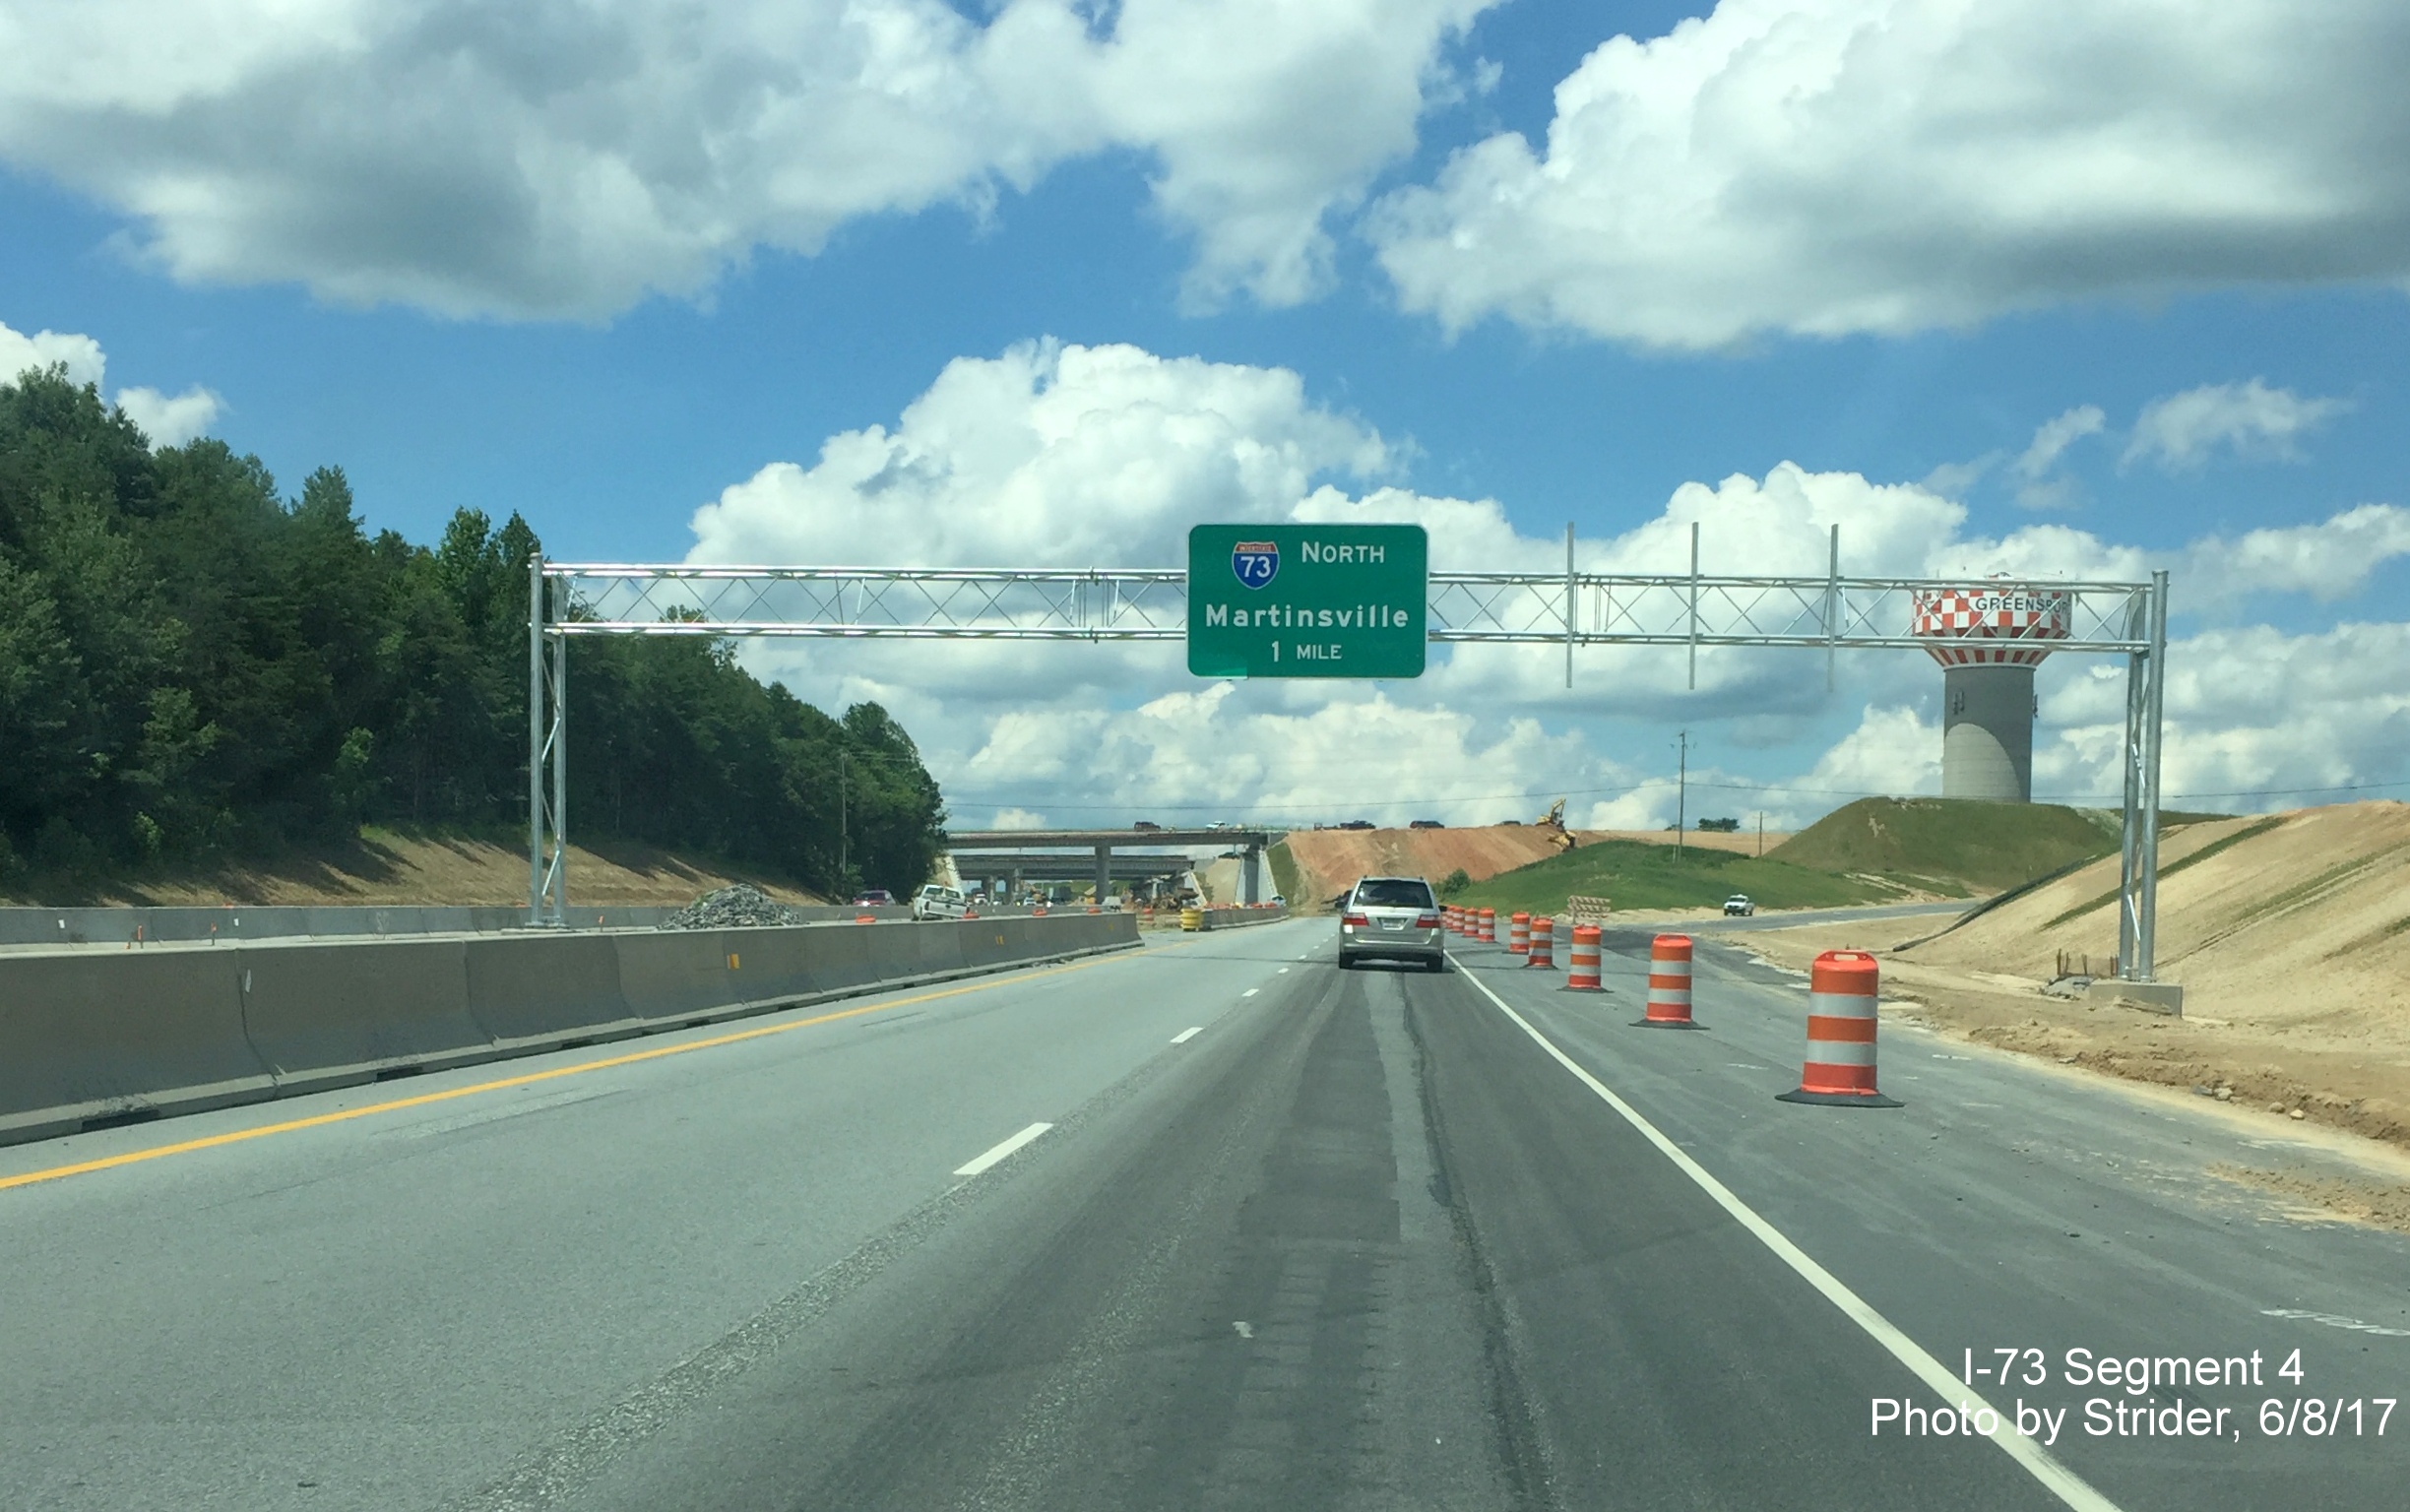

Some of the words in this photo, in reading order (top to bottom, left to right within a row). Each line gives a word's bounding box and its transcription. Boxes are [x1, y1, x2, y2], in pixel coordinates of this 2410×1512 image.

[1301, 541, 1385, 563] NORTH
[1240, 555, 1271, 578] 73
[1206, 603, 1409, 627] Martinsville
[1271, 641, 1280, 662] 1
[1297, 644, 1342, 660] MILE
